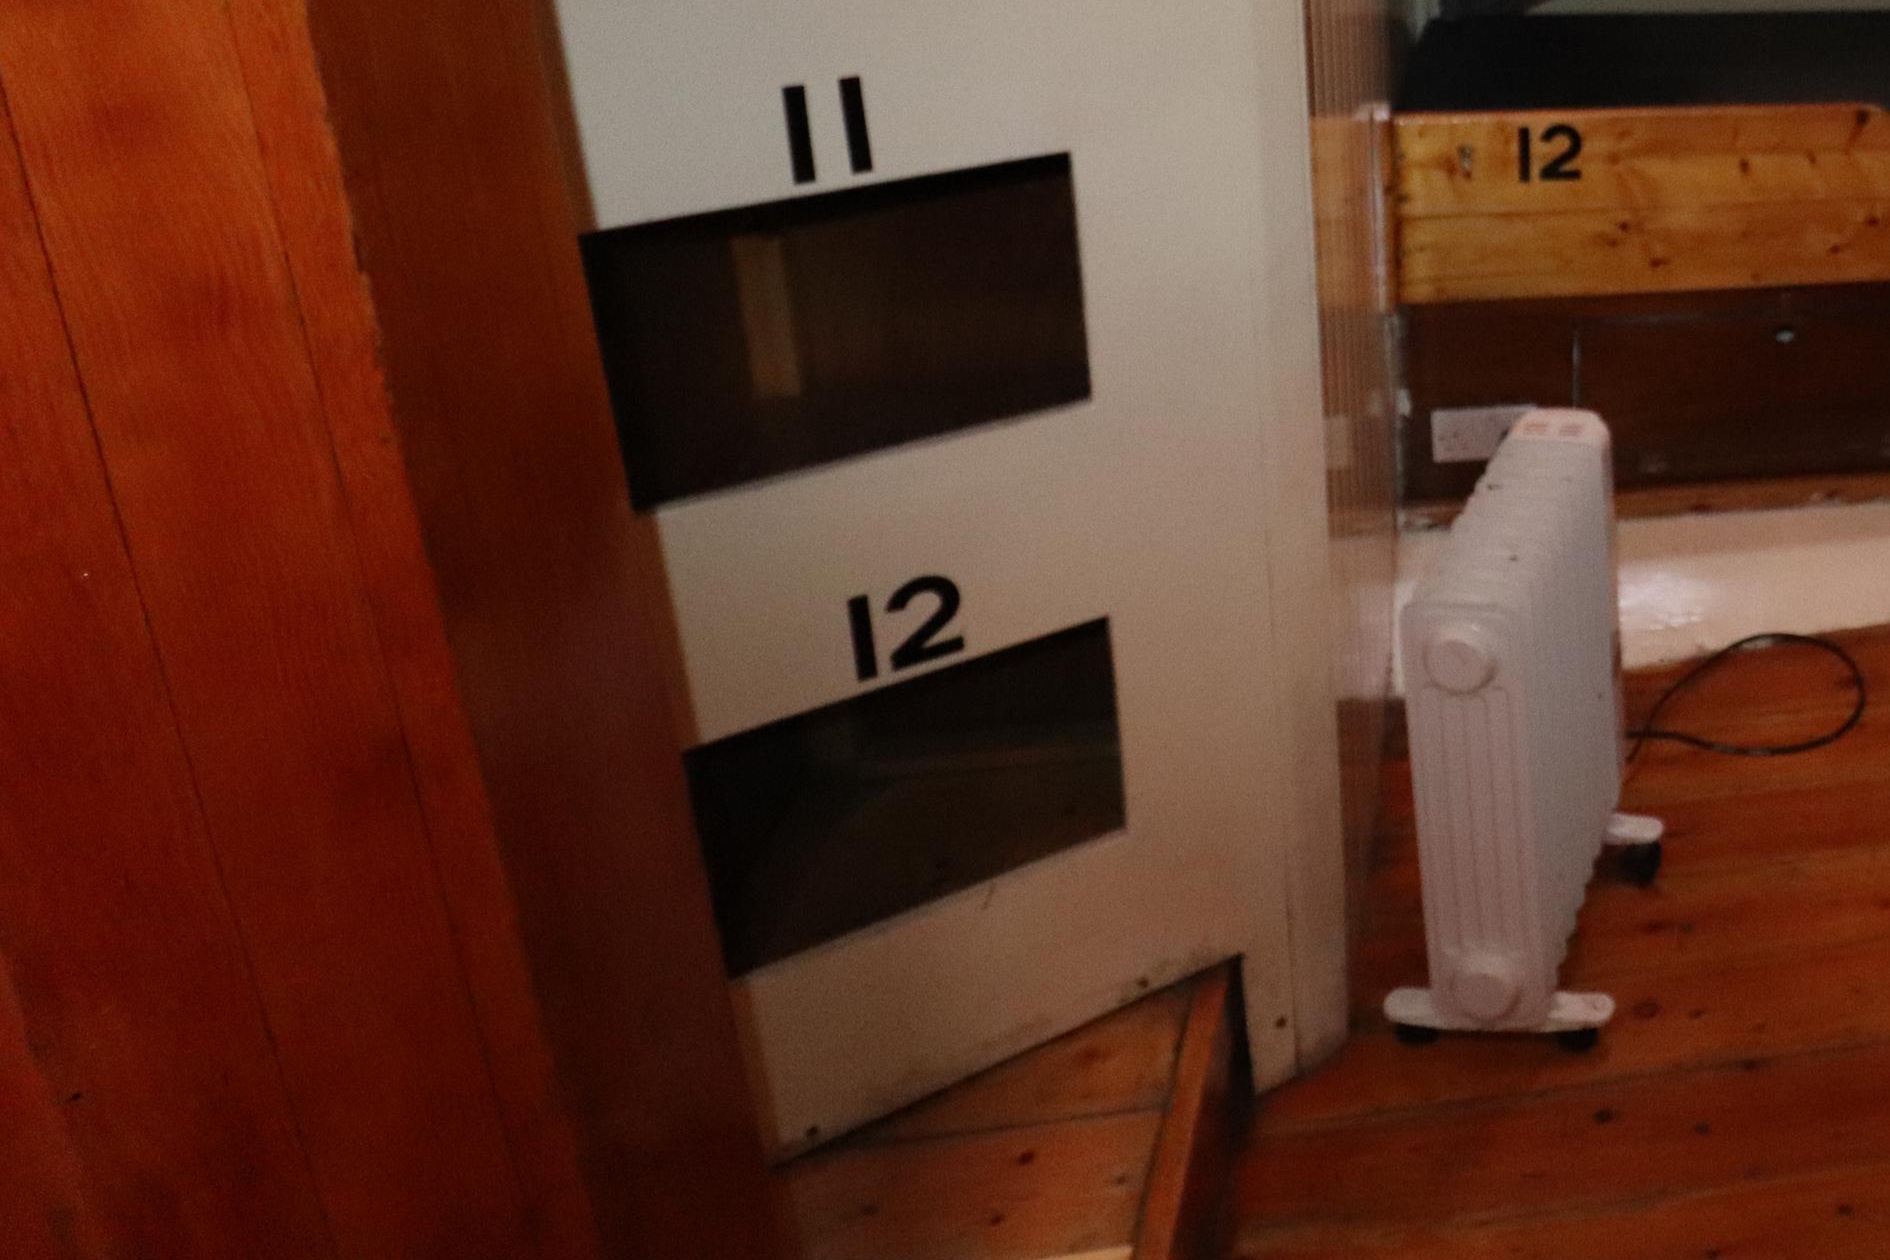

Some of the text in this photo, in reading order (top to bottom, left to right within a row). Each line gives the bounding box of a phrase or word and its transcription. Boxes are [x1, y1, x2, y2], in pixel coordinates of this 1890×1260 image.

[783, 76, 873, 185] 11
[1518, 124, 1583, 182] 12
[848, 576, 964, 683] 12
